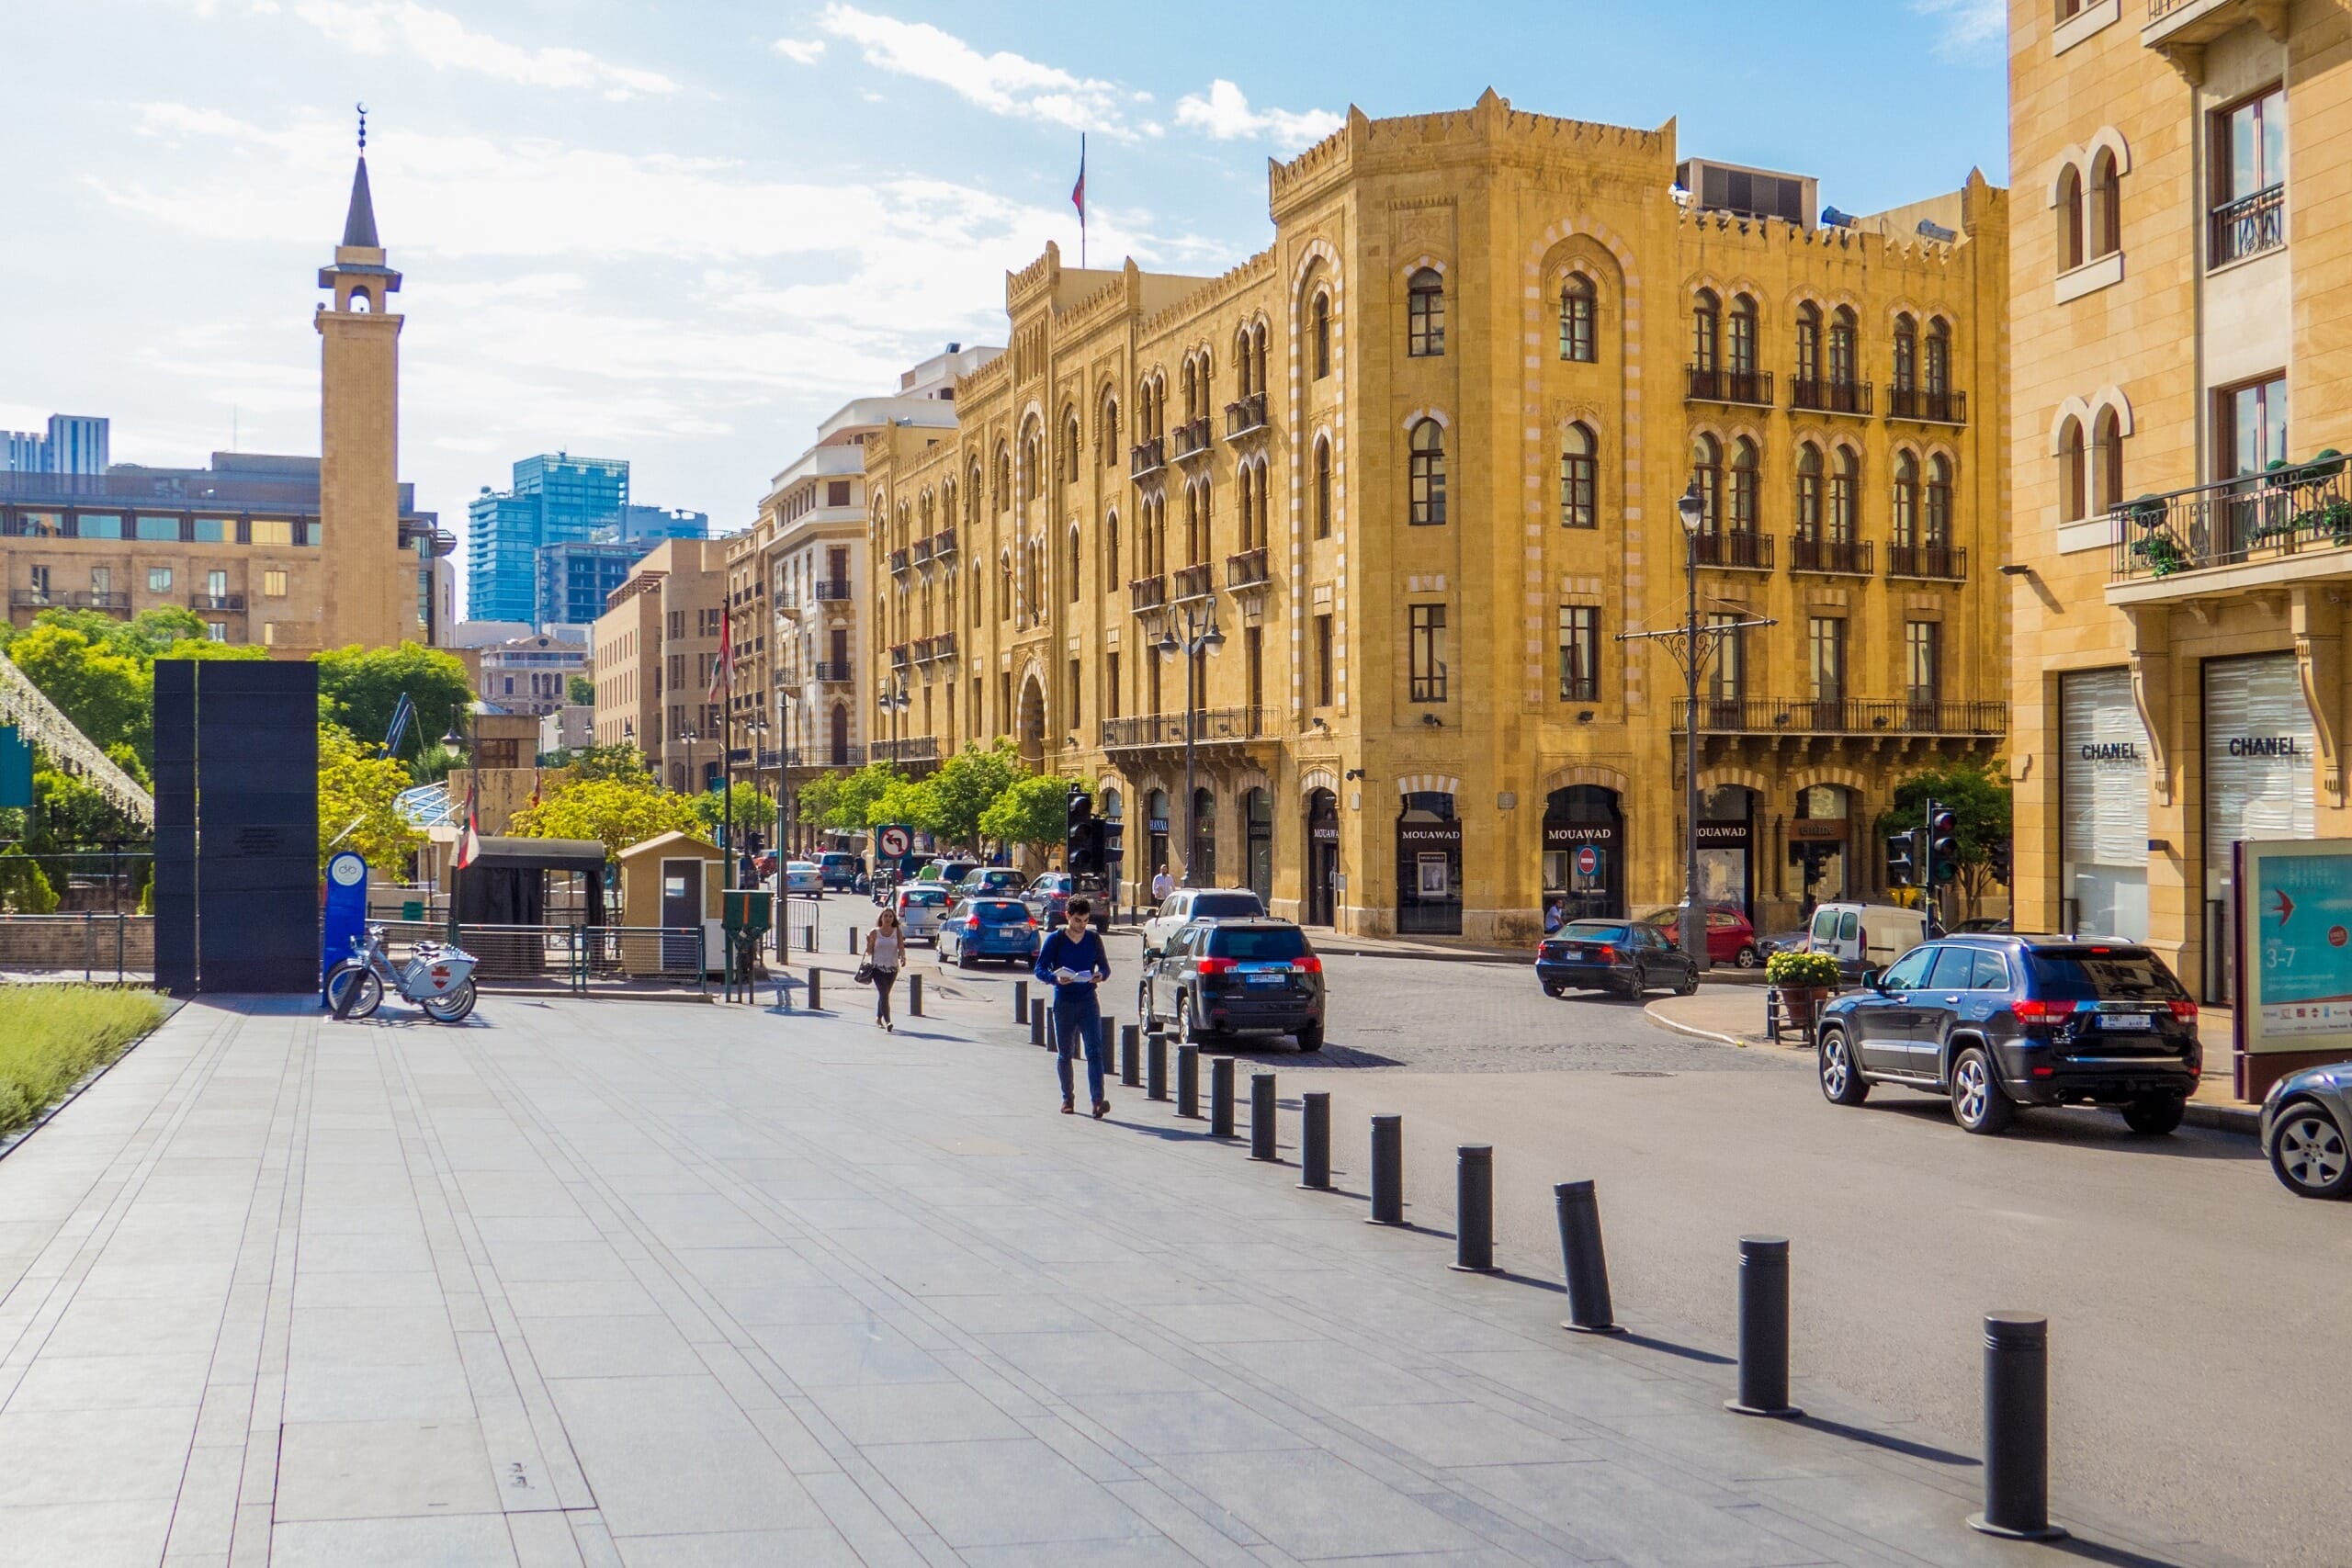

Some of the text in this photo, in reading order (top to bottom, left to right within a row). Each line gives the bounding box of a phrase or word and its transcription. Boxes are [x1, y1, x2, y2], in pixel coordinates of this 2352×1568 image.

[2082, 742, 2138, 761] CHANEL
[2229, 737, 2300, 756] CHANEL
[1314, 829, 1339, 838] MOUAWA
[1403, 830, 1460, 839] MOUAWAD
[1549, 829, 1611, 840] MOUAWAD
[1696, 828, 1746, 837] OUAWAD
[2267, 947, 2296, 968] 3-7
